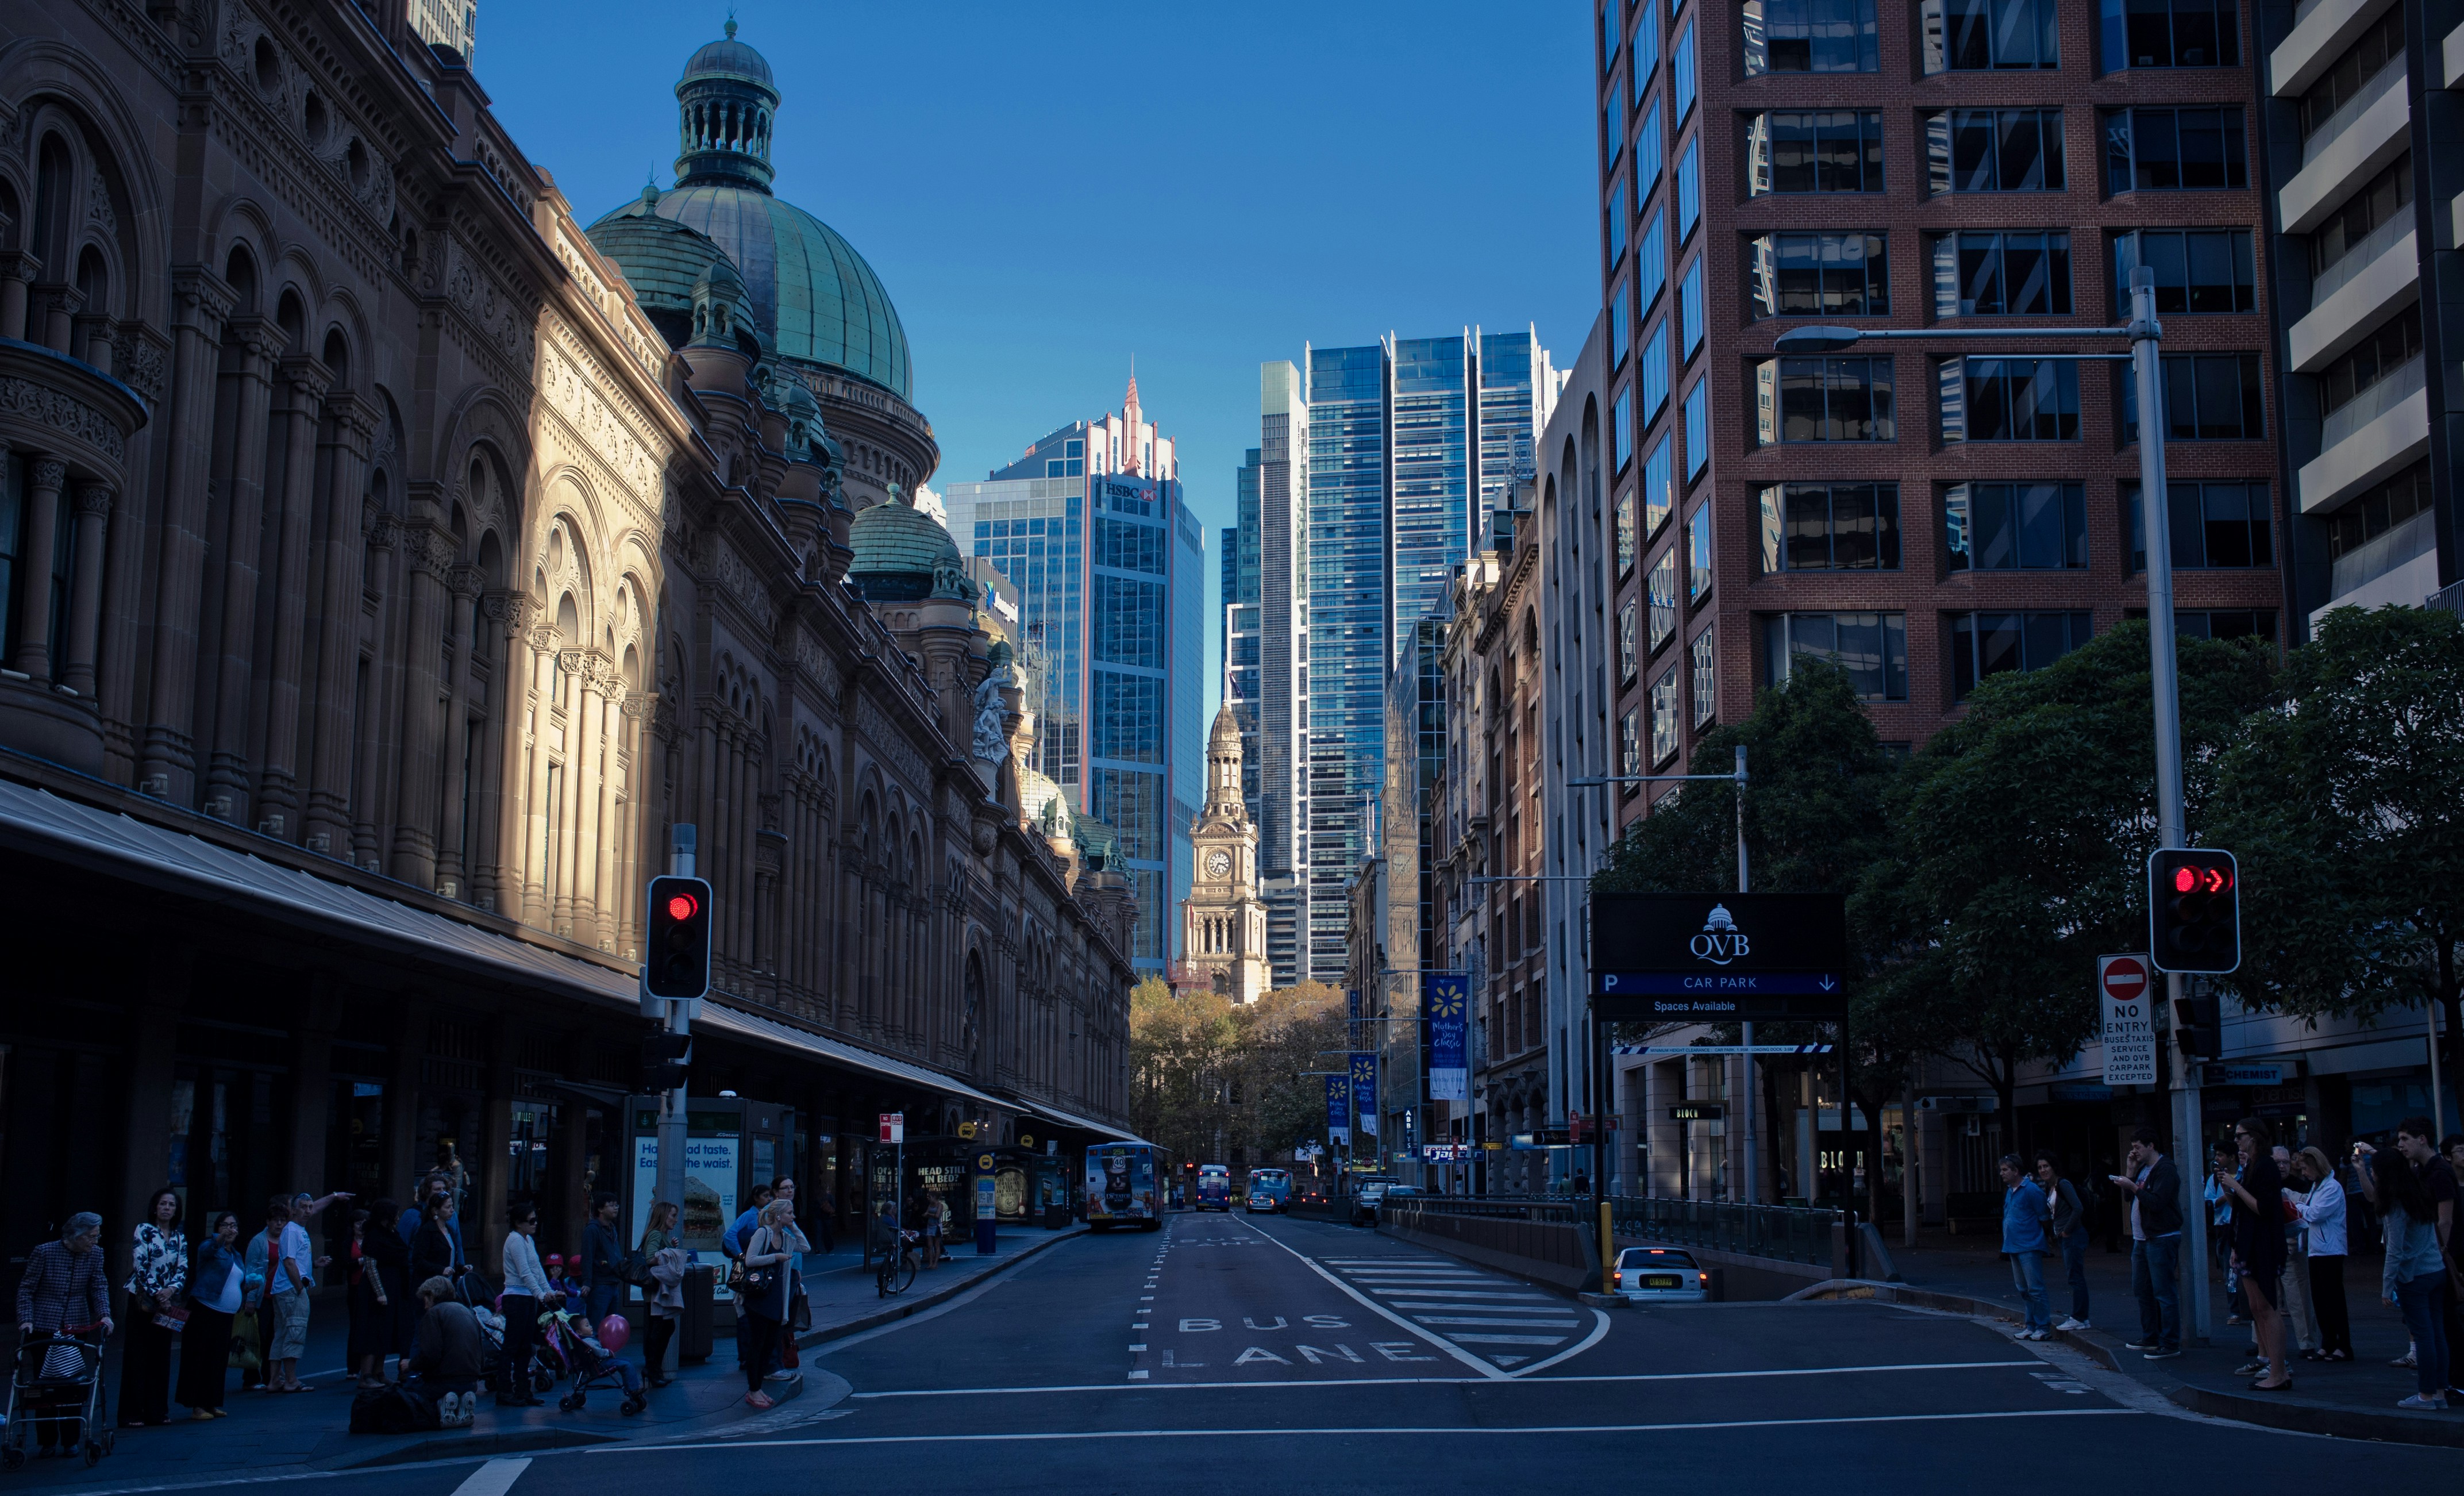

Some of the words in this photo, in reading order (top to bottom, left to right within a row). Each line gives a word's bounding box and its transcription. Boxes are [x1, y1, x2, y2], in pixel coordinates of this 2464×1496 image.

[1106, 483, 1139, 499] HSBC
[1690, 934, 1750, 965] QVB
[1605, 975, 1618, 991] P
[1684, 978, 1712, 988] CAR
[1720, 978, 1757, 988] PARK
[1654, 1001, 1689, 1012] Spaces
[1693, 1001, 1735, 1011] Available
[2115, 1005, 2138, 1018] NO
[1433, 1021, 1463, 1032] Mother's
[2107, 1022, 2148, 1033] ENTRY
[1442, 1030, 1456, 1040] Day
[1434, 1038, 1461, 1049] Classic
[2226, 1070, 2277, 1079] CHEMIST
[2252, 1083, 2305, 1102] Chemist
[1676, 1109, 1698, 1118] BLOCH
[703, 1144, 731, 1154] taste.
[640, 1157, 657, 1167] Eas
[703, 1157, 732, 1168] waist.
[1820, 1151, 1864, 1168] BLOH
[918, 1167, 942, 1175] HEAD
[945, 1166, 966, 1174] STILL
[925, 1175, 934, 1183] IN
[937, 1174, 959, 1183] BED?
[1179, 1315, 1352, 1332] BUS
[1161, 1342, 1439, 1368] LANE
